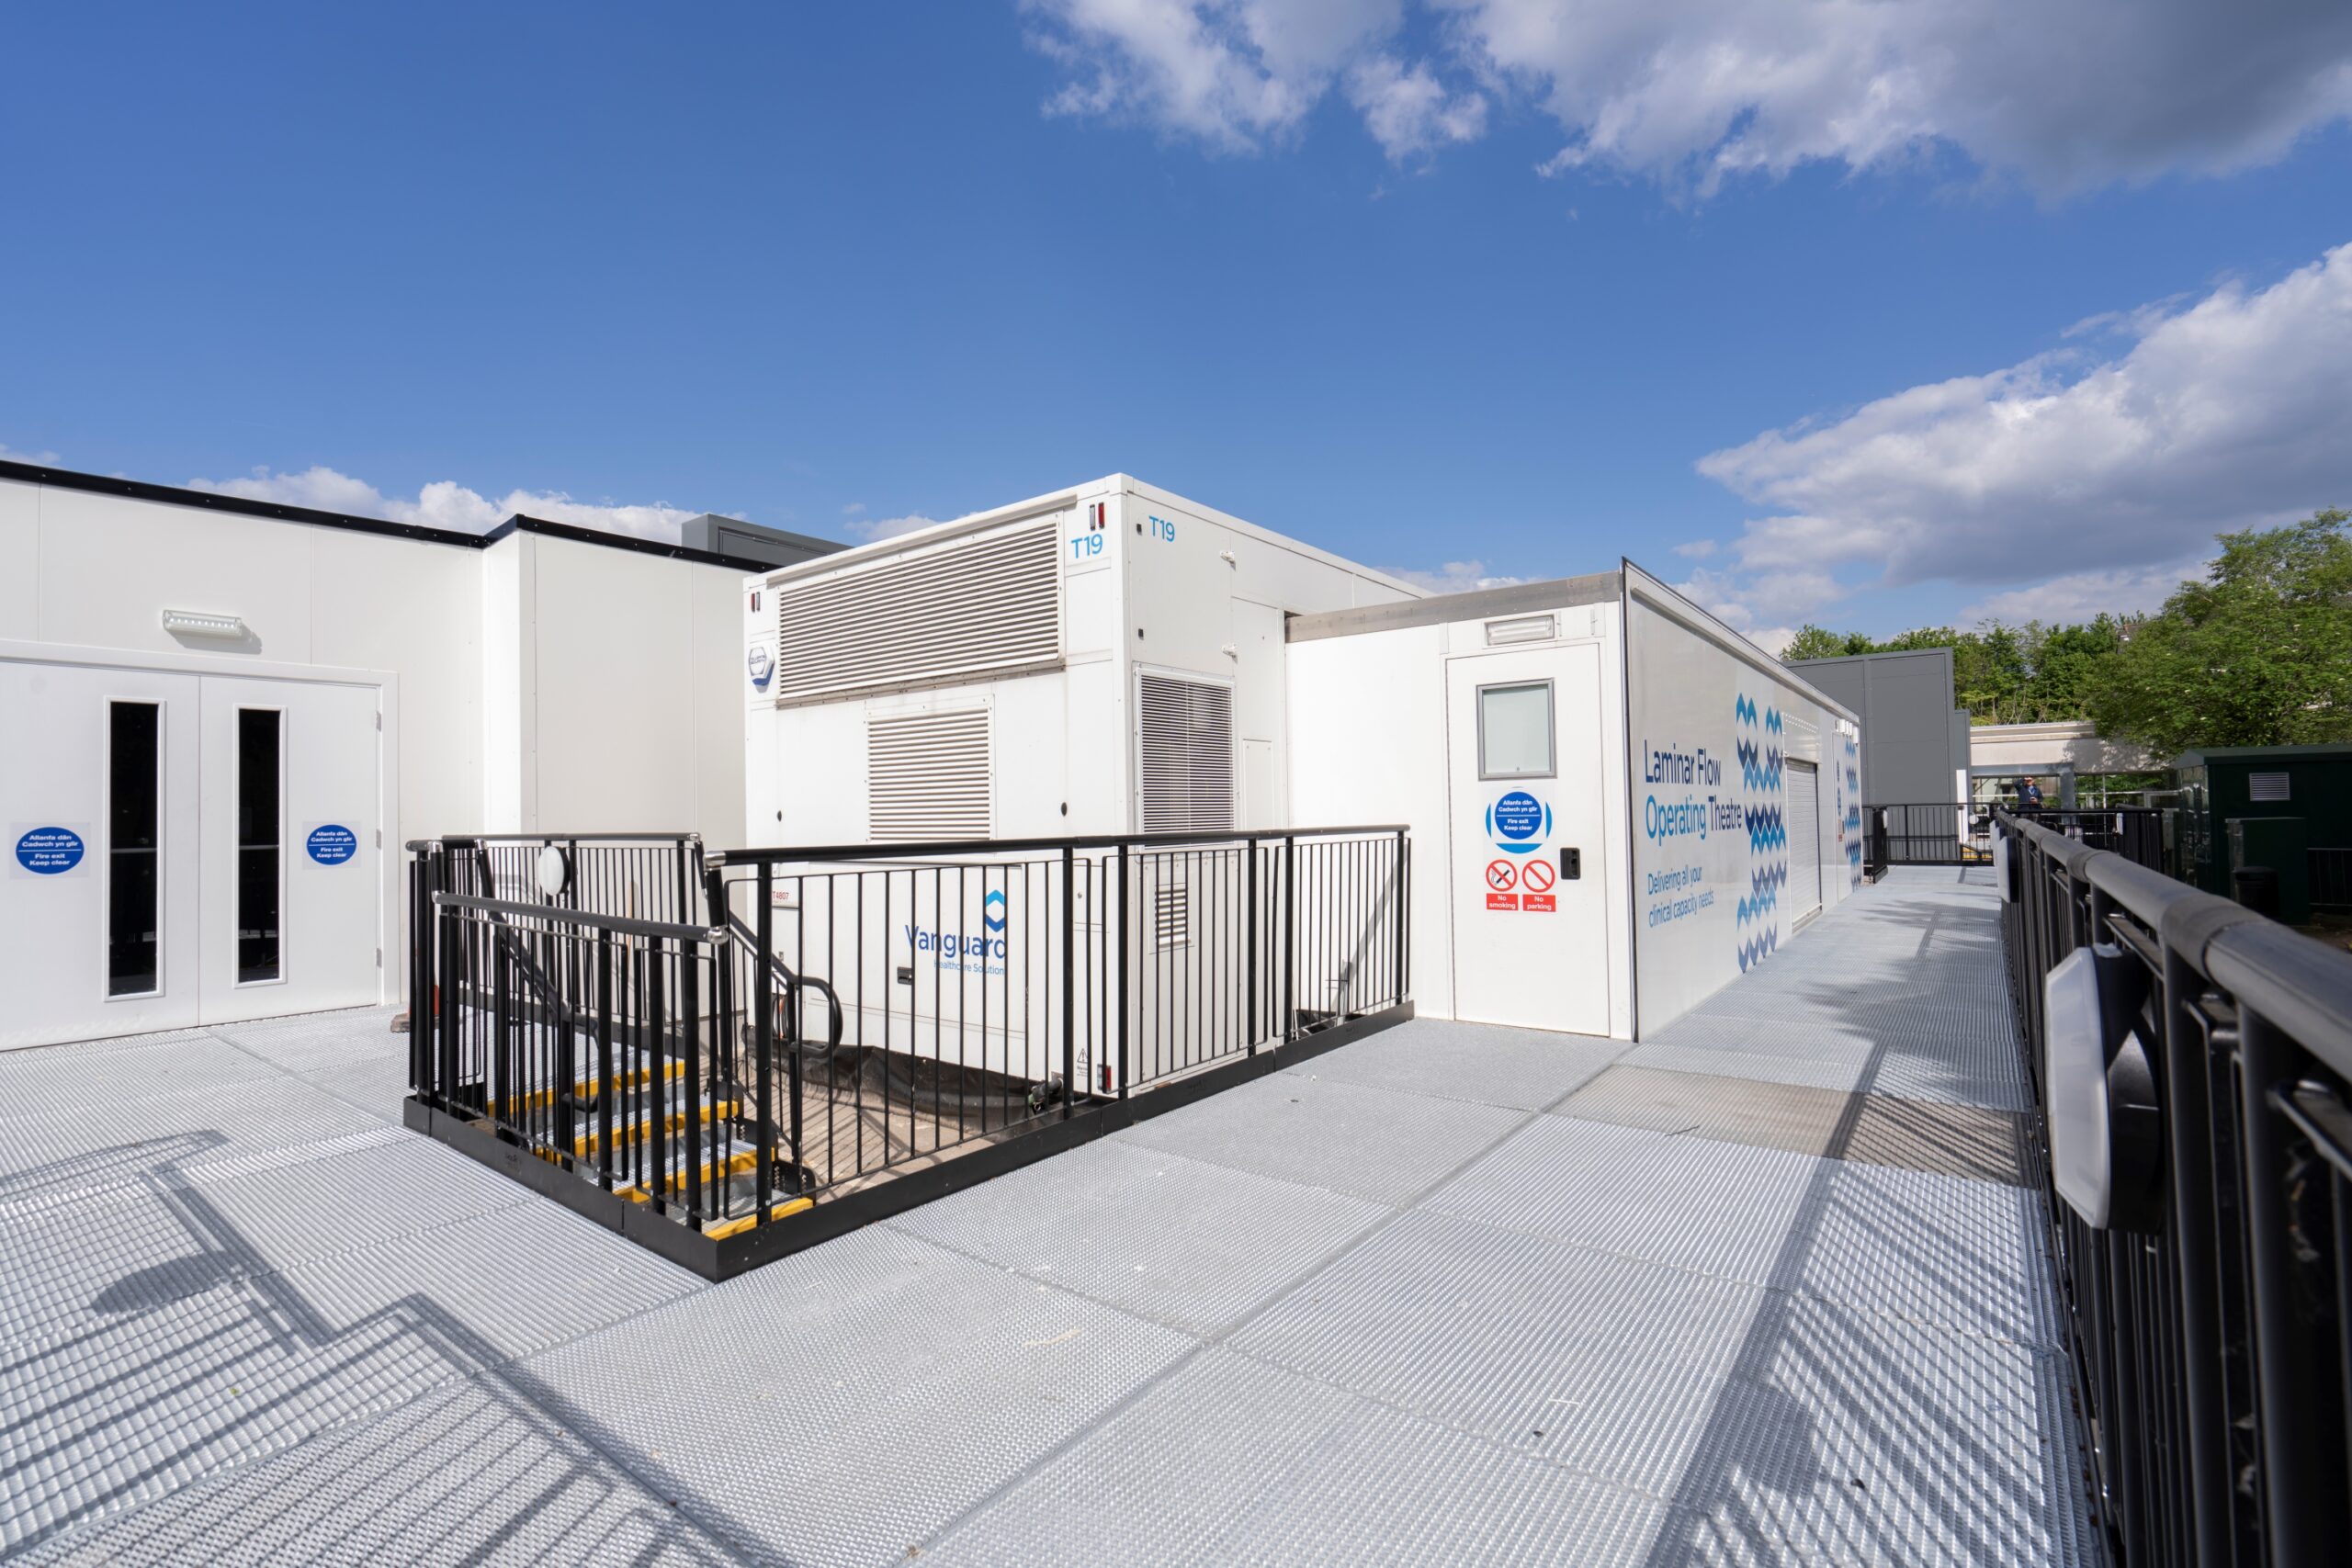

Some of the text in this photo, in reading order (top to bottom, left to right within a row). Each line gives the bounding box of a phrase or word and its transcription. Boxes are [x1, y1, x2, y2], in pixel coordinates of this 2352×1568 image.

[1149, 515, 1175, 542] T19
[1071, 534, 1102, 558] T19
[1645, 739, 1721, 786] Laminar Flow
[1645, 794, 1742, 847] Operating Theatre
[1647, 868, 1681, 896] Delivering
[1690, 867, 1702, 887] your
[1649, 886, 1713, 928] clinical capacity needs
[933, 959, 1005, 976] ealthcre Soution
